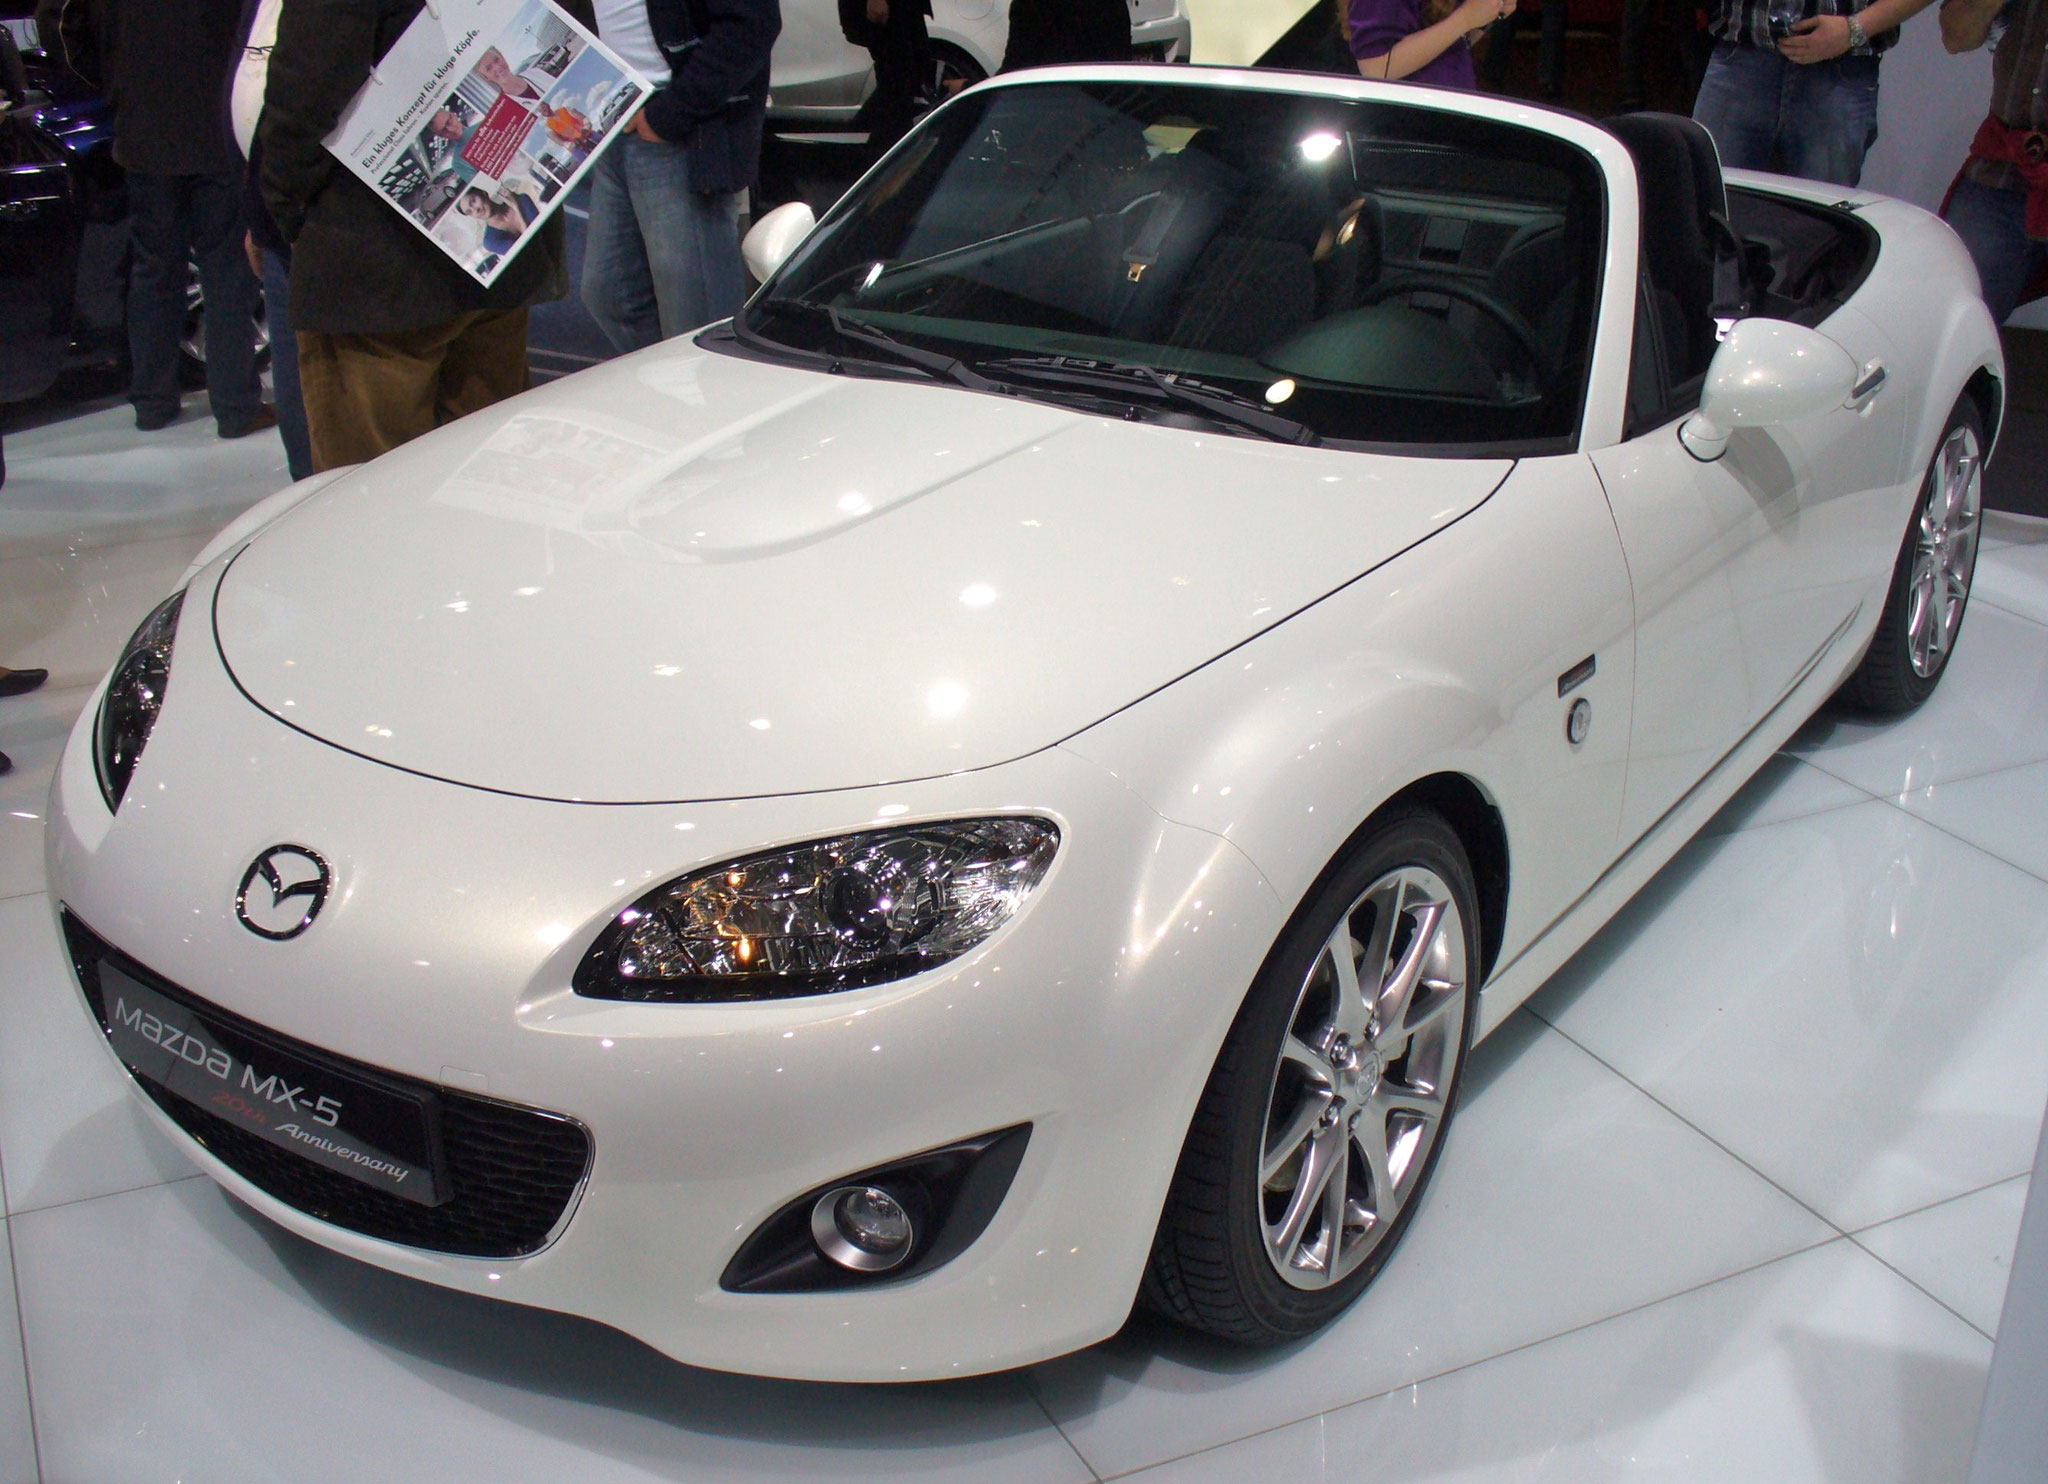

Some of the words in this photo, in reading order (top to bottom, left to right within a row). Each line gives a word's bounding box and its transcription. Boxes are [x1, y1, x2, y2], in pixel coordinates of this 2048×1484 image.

[362, 154, 377, 168] Ein
[373, 127, 399, 154] kluges
[396, 92, 427, 127] Konzept
[423, 80, 437, 93] für
[433, 56, 457, 79] kluge
[453, 29, 481, 55] Köpfe.
[240, 1064, 343, 1128] MX-5
[274, 1121, 408, 1183] Anniversary
